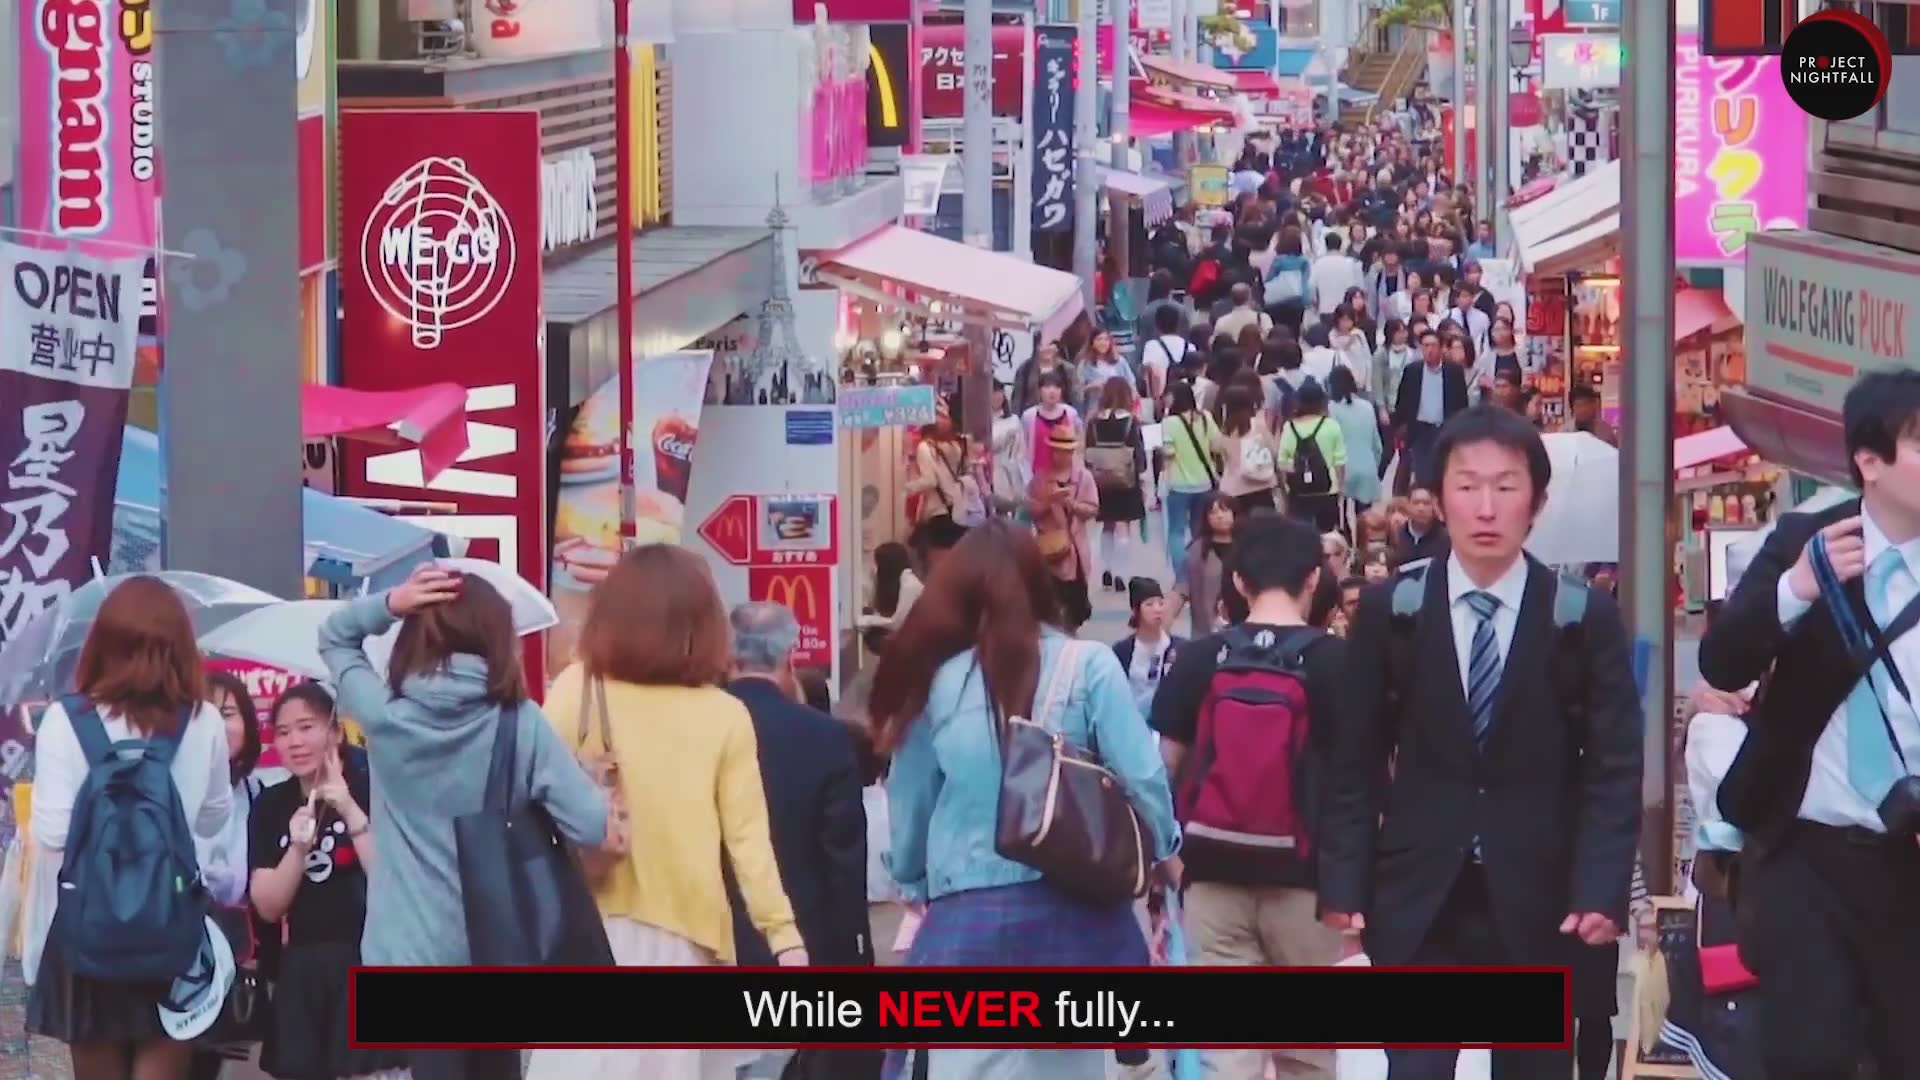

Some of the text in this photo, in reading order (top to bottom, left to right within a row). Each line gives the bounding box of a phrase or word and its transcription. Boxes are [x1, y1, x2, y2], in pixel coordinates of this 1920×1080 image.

[1592, 3, 1608, 20] 1F
[132, 61, 153, 180] STUDIO
[1675, 46, 1699, 198] PURIKURA
[1036, 130, 1071, 228] ハセガワ
[14, 260, 121, 323] OPEN
[1764, 266, 1904, 357] WOLFGANG PUCK
